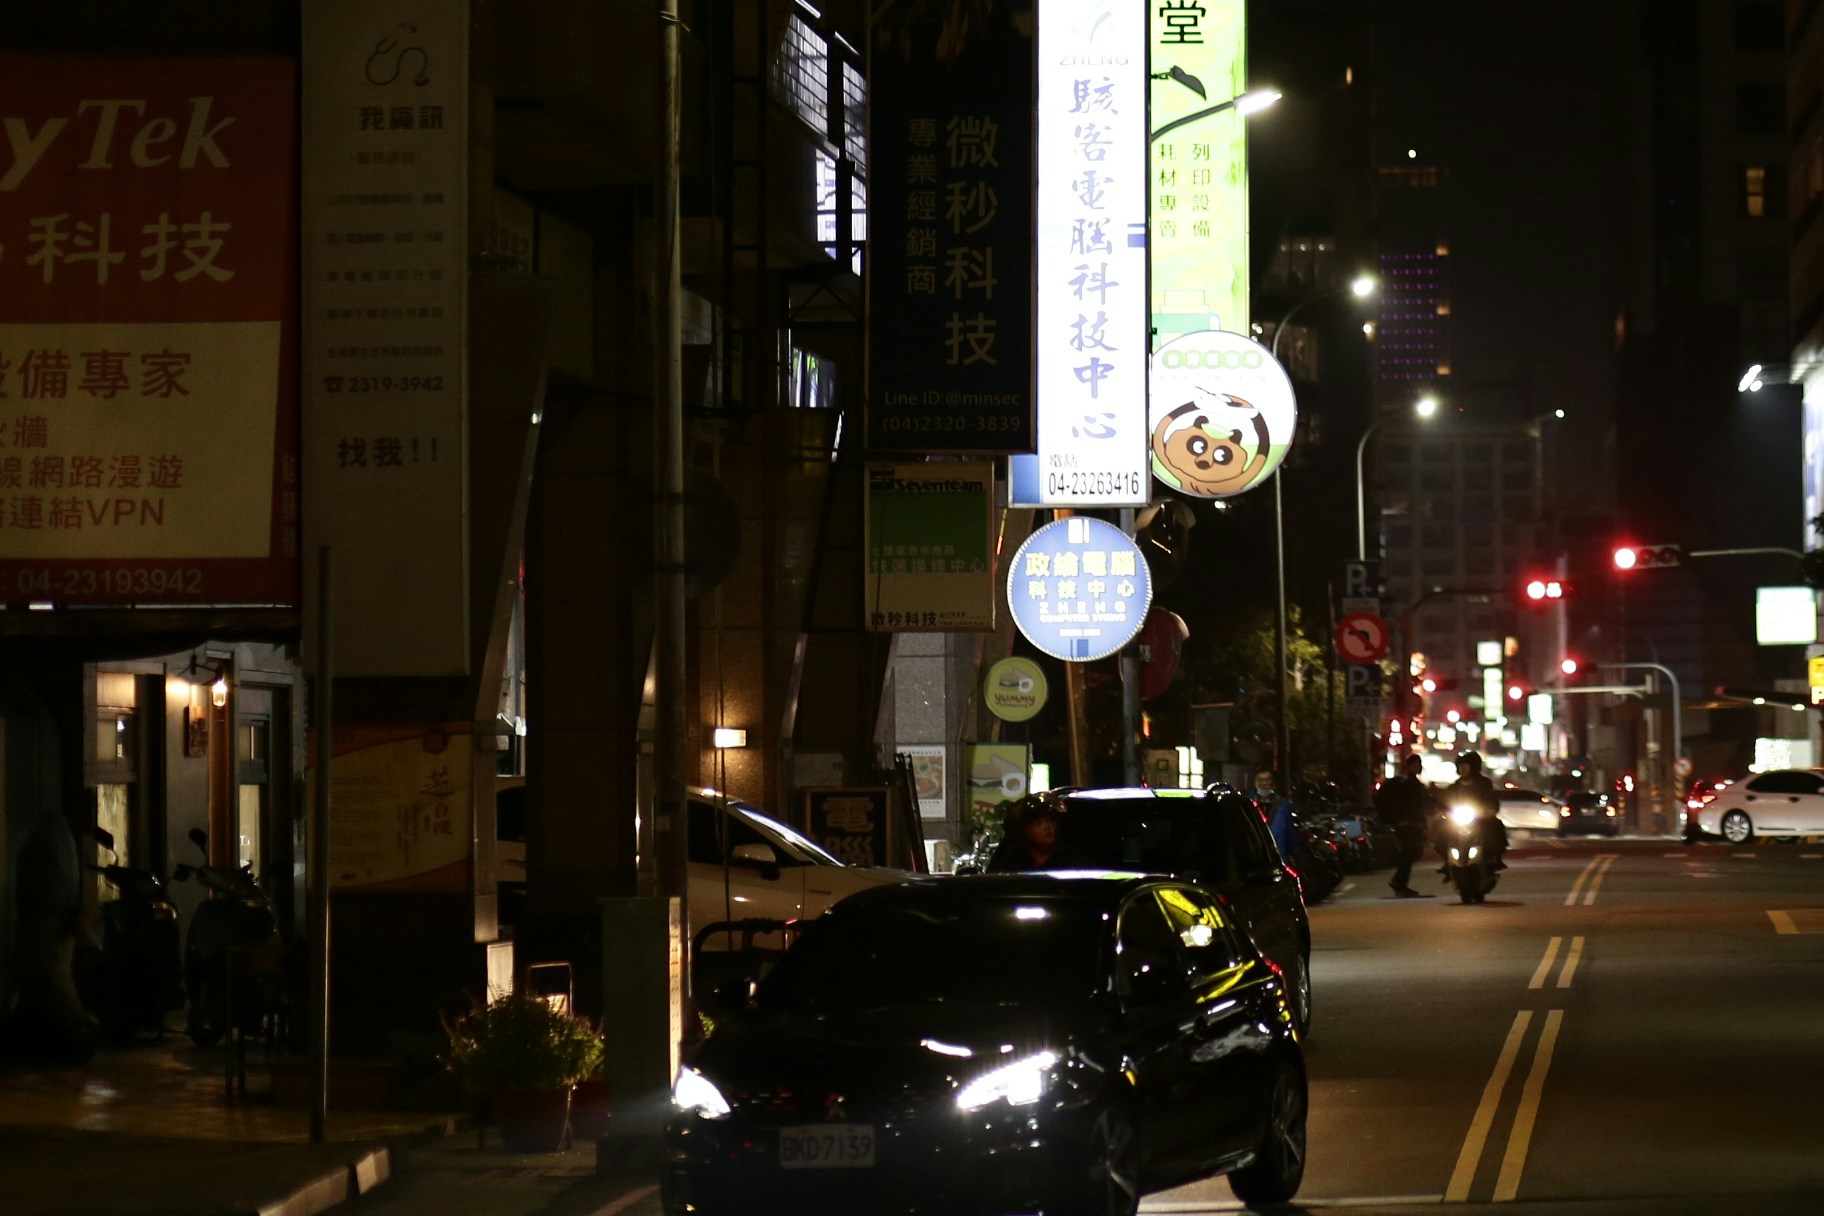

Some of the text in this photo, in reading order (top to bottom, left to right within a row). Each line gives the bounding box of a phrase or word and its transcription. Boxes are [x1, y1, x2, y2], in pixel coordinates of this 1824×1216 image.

[1191, 142, 1211, 238] 列印設備
[906, 118, 938, 295] 專業經銷商
[0, 212, 236, 285] 科技
[945, 115, 999, 367] 微秒科技
[1067, 77, 1121, 440] 駭客電腦科技中心
[349, 377, 443, 393] 2319-3942
[884, 390, 919, 406] Line
[882, 416, 1022, 434] (04)2320-3839
[1048, 472, 1139, 495] 04-23263416
[0, 496, 164, 530] 連結VPN
[18, 569, 204, 595] 04-23193942
[1346, 564, 1367, 596] P
[1039, 601, 1126, 613] ZHENG
[1348, 666, 1370, 696] P
